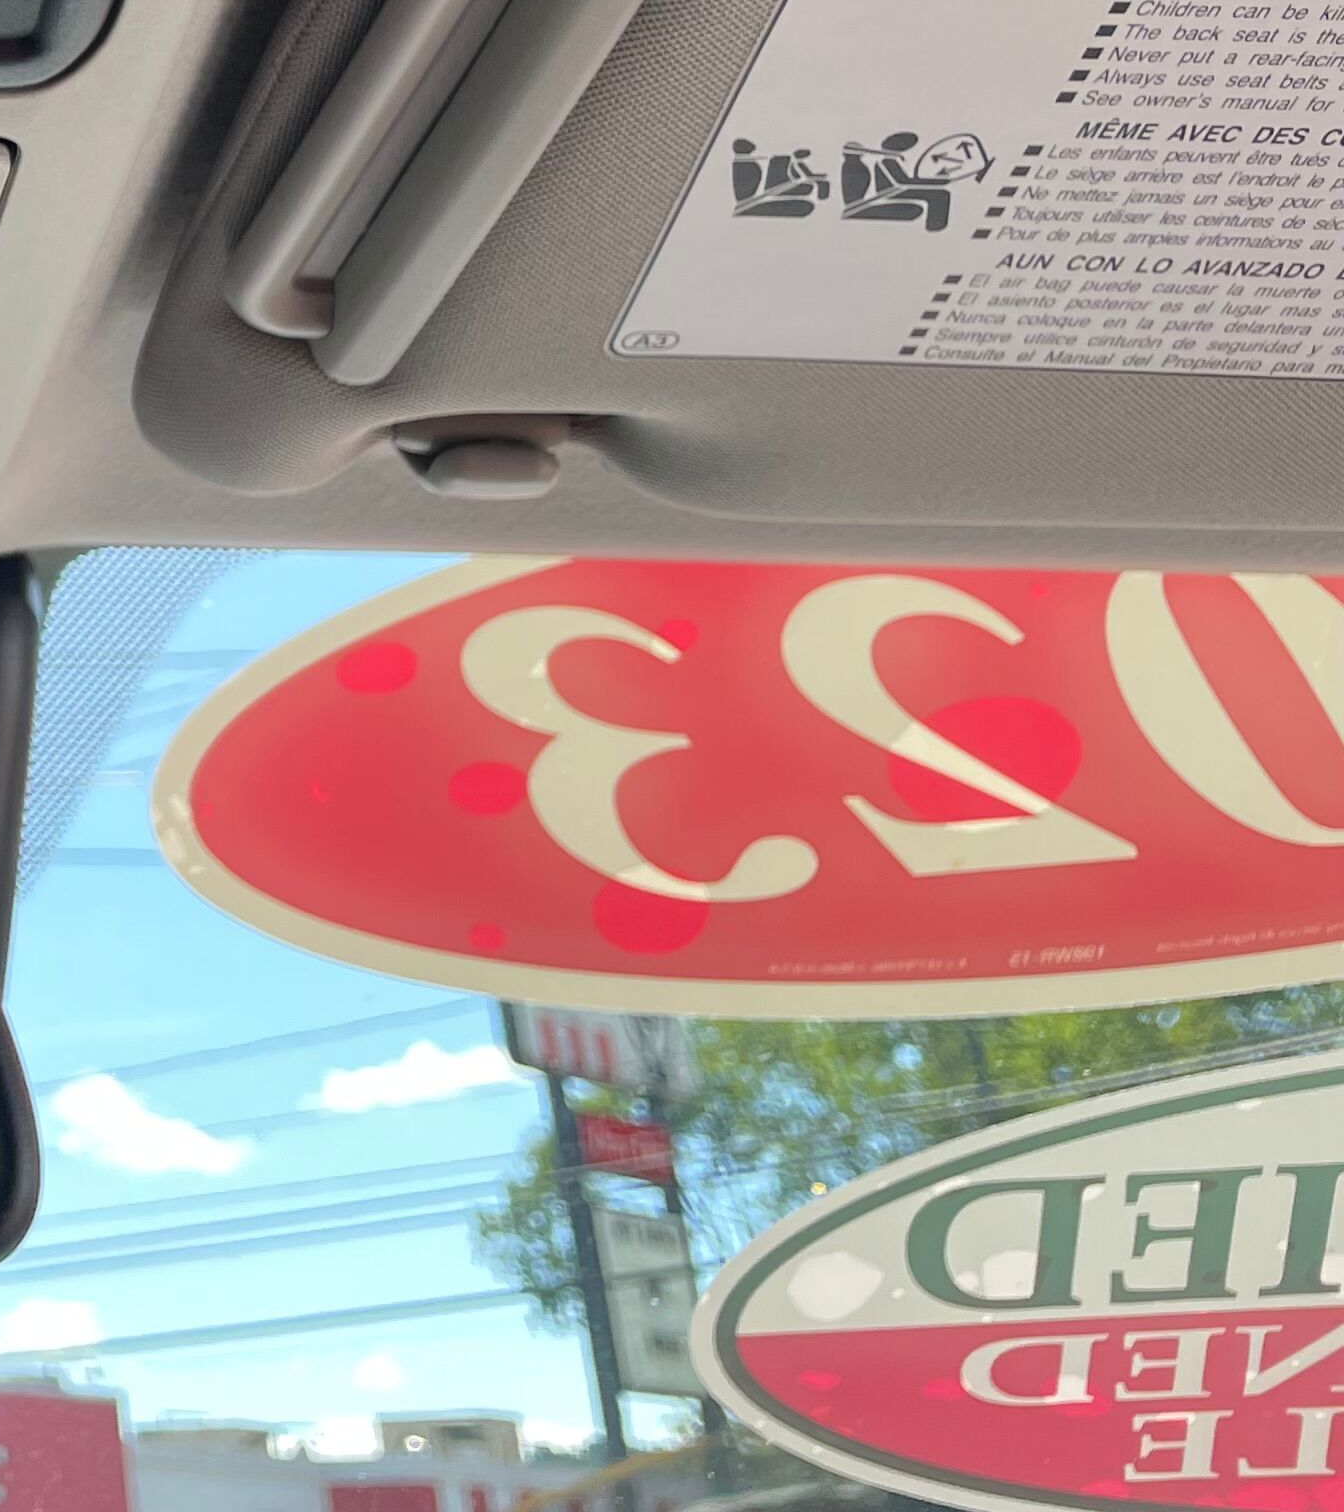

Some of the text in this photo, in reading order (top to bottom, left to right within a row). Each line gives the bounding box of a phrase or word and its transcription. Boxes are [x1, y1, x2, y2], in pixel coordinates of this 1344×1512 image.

[1136, 0, 1222, 19] Children
[1232, 6, 1271, 20] can
[1281, 4, 1309, 21] be
[1123, 23, 1162, 41] The
[1172, 24, 1223, 42] back
[1232, 27, 1280, 44] seat
[1287, 27, 1307, 45] is
[1107, 46, 1171, 65] Never
[1176, 49, 1215, 67] put
[1223, 51, 1238, 66] a
[1092, 69, 1168, 88] Always
[1177, 73, 1215, 88] use
[1225, 71, 1273, 89] seat
[1278, 73, 1330, 91] belts
[1081, 89, 1336, 114] See owner's manual for
[1075, 117, 1160, 141] MÊME
[1166, 124, 1244, 143] AVEC
[1251, 126, 1311, 145] DES
[1047, 143, 1082, 161] Les
[1089, 144, 1159, 163] enfants
[1163, 148, 1242, 167] peuvent
[1246, 148, 1284, 166] être
[1290, 151, 1332, 168] tués
[1033, 165, 1058, 181] Le
[1065, 166, 1117, 186] siège
[1123, 168, 1185, 185] arrière
[1192, 172, 1221, 186] est
[1226, 170, 1302, 188] l'endroit
[1306, 172, 1326, 189] le
[1020, 185, 1048, 201] Ne
[1055, 186, 1119, 204] mettez
[1123, 189, 1186, 207] jamais
[1192, 193, 1219, 206] un
[1223, 191, 1274, 211] siège
[1278, 196, 1327, 212] pour
[995, 252, 1055, 270] AUN
[1066, 254, 1125, 273] CON
[1134, 256, 1174, 275] LO
[1181, 259, 1326, 279] AVANZADO
[969, 273, 991, 288] El
[999, 276, 1027, 290] air
[1035, 276, 1072, 294] bag
[1079, 278, 1142, 295] puede
[1151, 281, 1219, 296] causar
[1226, 283, 1244, 297] la
[1253, 286, 1322, 301] muerte
[957, 291, 980, 307] El
[987, 294, 1056, 309] asiento
[1064, 296, 1153, 312] posterior
[1159, 301, 1184, 315] es
[1193, 301, 1214, 315] el
[1220, 301, 1272, 319] lugar
[945, 309, 1007, 326] Nunca
[1016, 312, 1091, 330] coloque
[1102, 317, 1127, 330] en
[1135, 316, 1155, 331] la
[1161, 317, 1215, 335] parte
[1223, 320, 1313, 337] delantera
